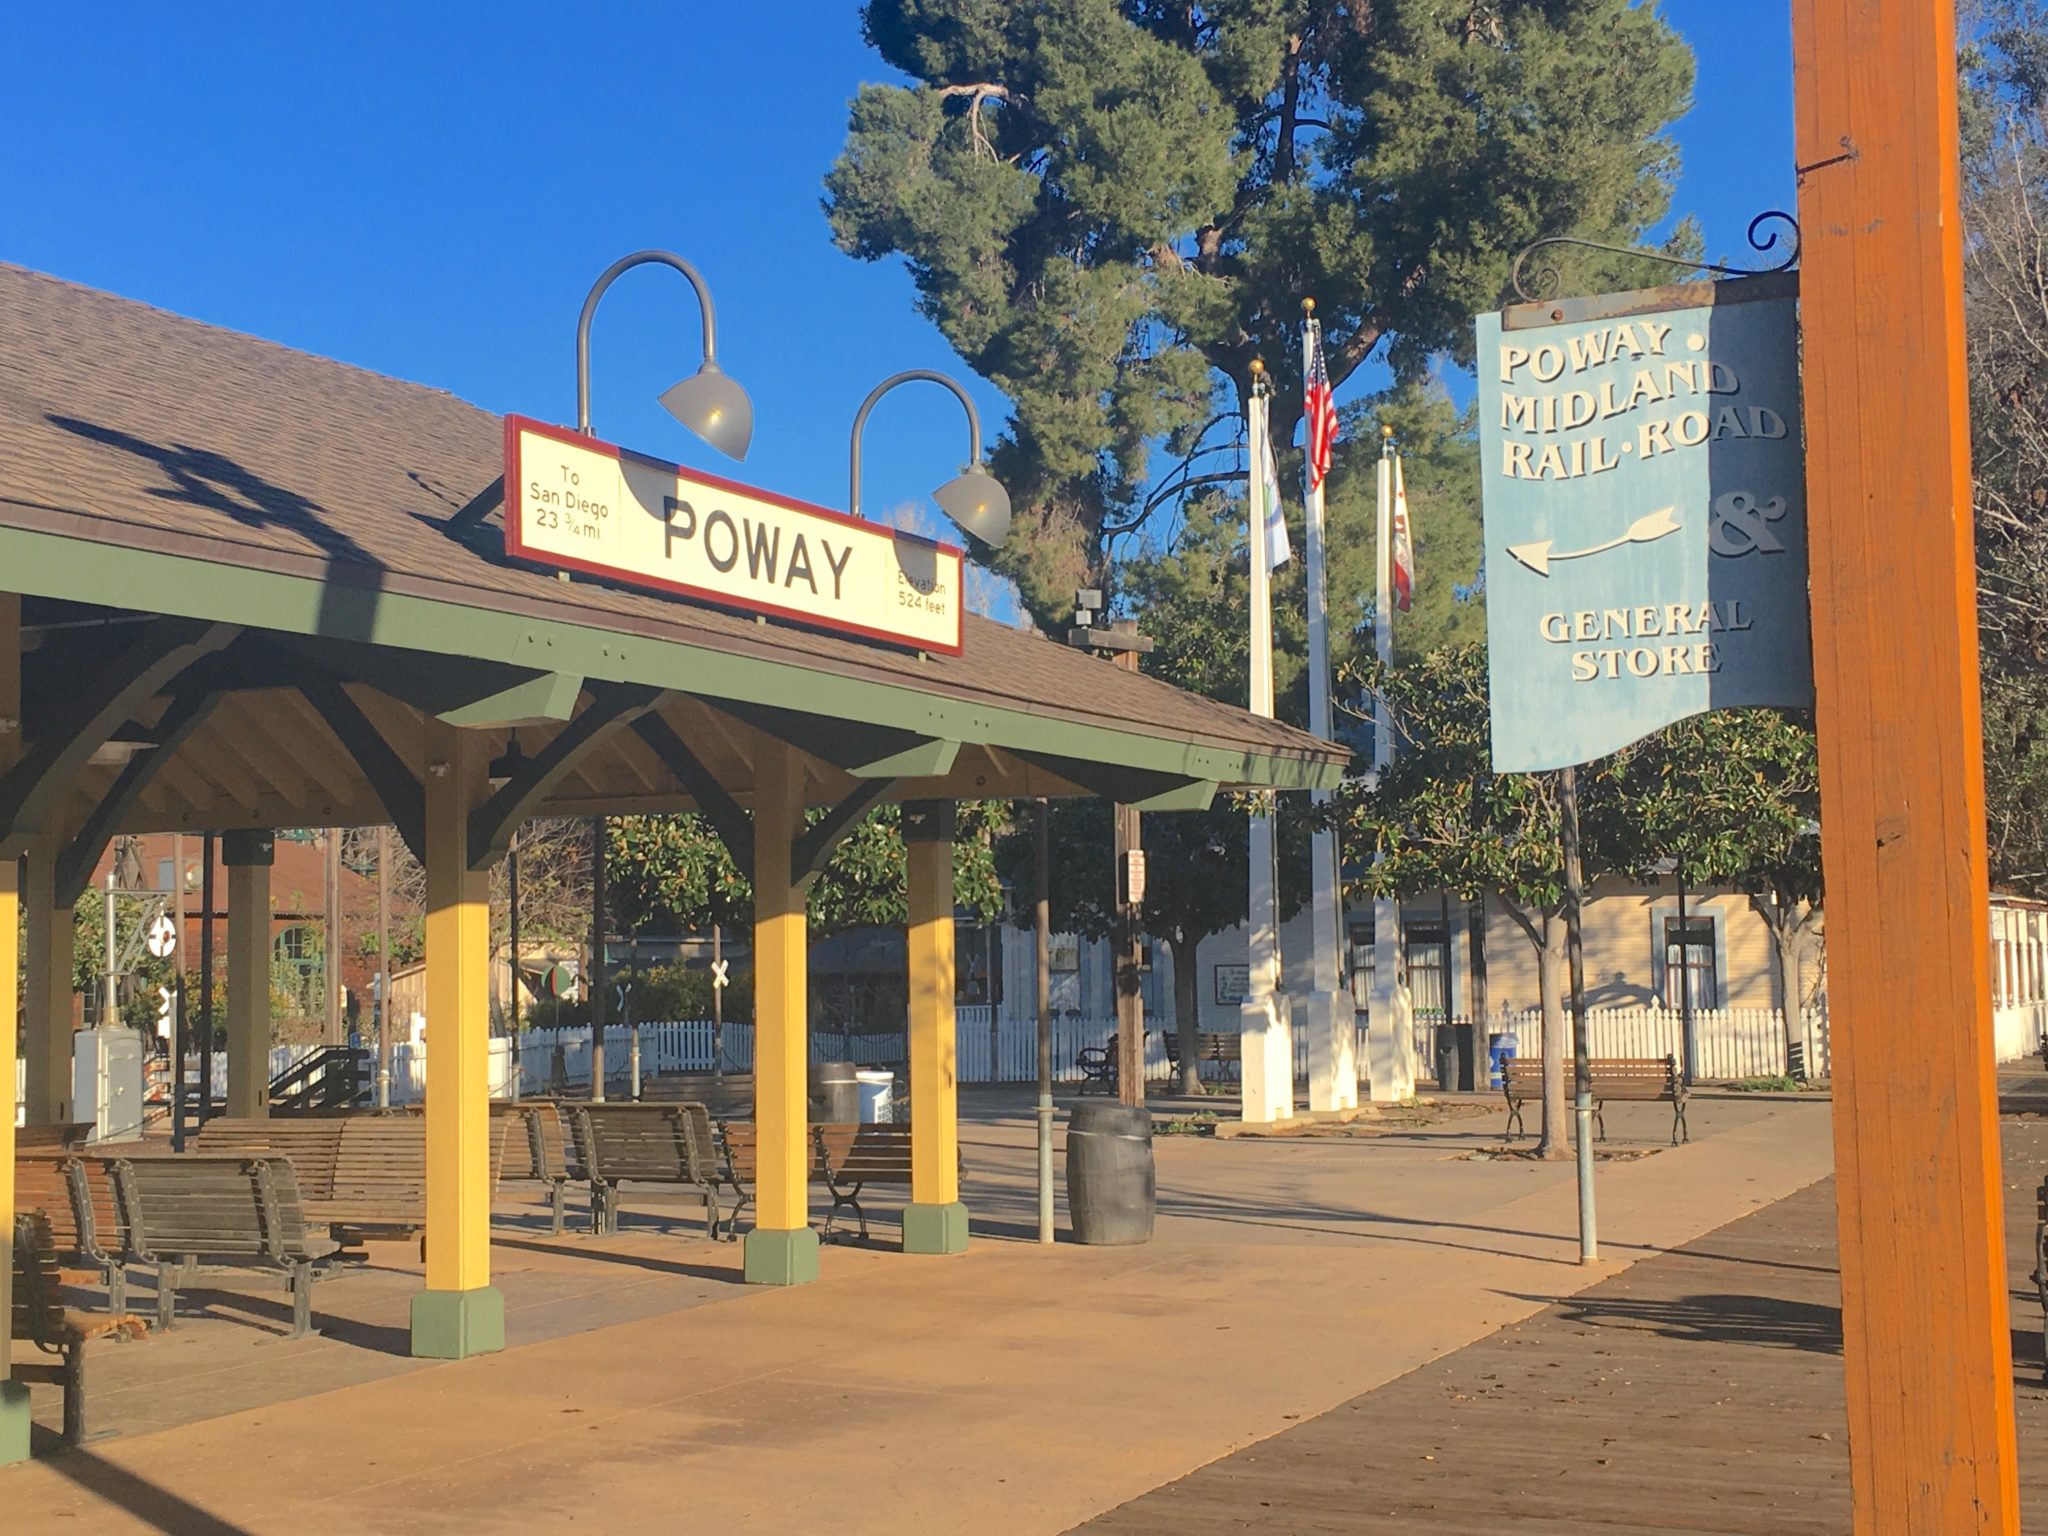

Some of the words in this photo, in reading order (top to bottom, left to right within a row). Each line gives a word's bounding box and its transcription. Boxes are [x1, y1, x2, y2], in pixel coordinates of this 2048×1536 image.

[1499, 322, 1672, 383] POWAY
[1500, 359, 1741, 433] MIDLAND
[561, 465, 580, 486] To
[530, 482, 560, 506] San
[565, 490, 608, 521] Diego
[536, 508, 558, 529] 23
[1711, 492, 1787, 557] &
[663, 495, 853, 600] POWAY
[899, 590, 922, 608] 524
[925, 597, 945, 615] feet
[1539, 600, 1753, 642] GENERAL
[1571, 643, 1723, 681] STORE
